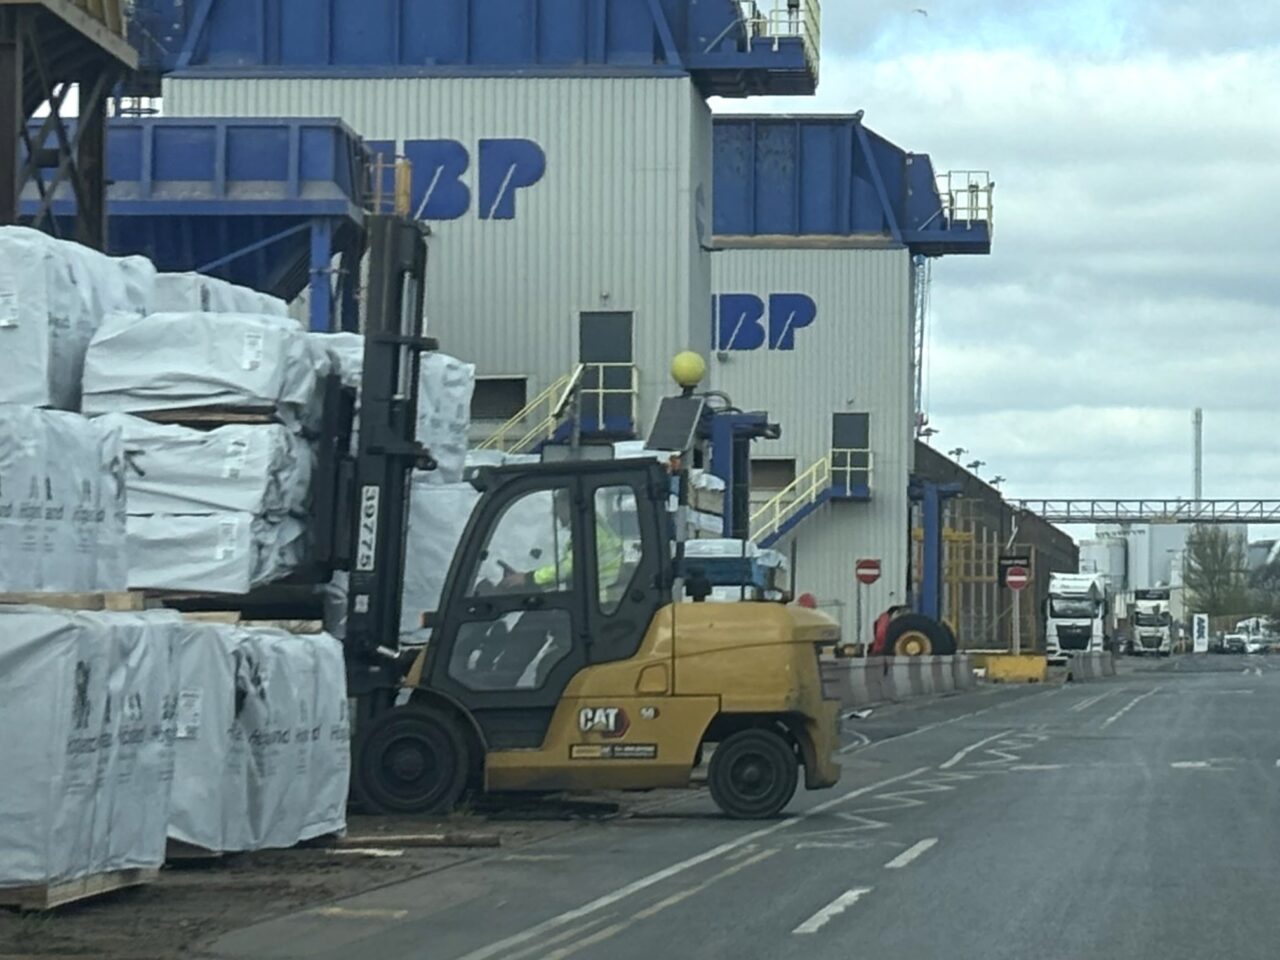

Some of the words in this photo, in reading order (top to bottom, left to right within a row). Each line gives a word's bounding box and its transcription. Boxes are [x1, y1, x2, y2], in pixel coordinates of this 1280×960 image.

[711, 293, 817, 351] BP
[361, 487, 377, 569] 39775
[579, 707, 619, 732] CAT
